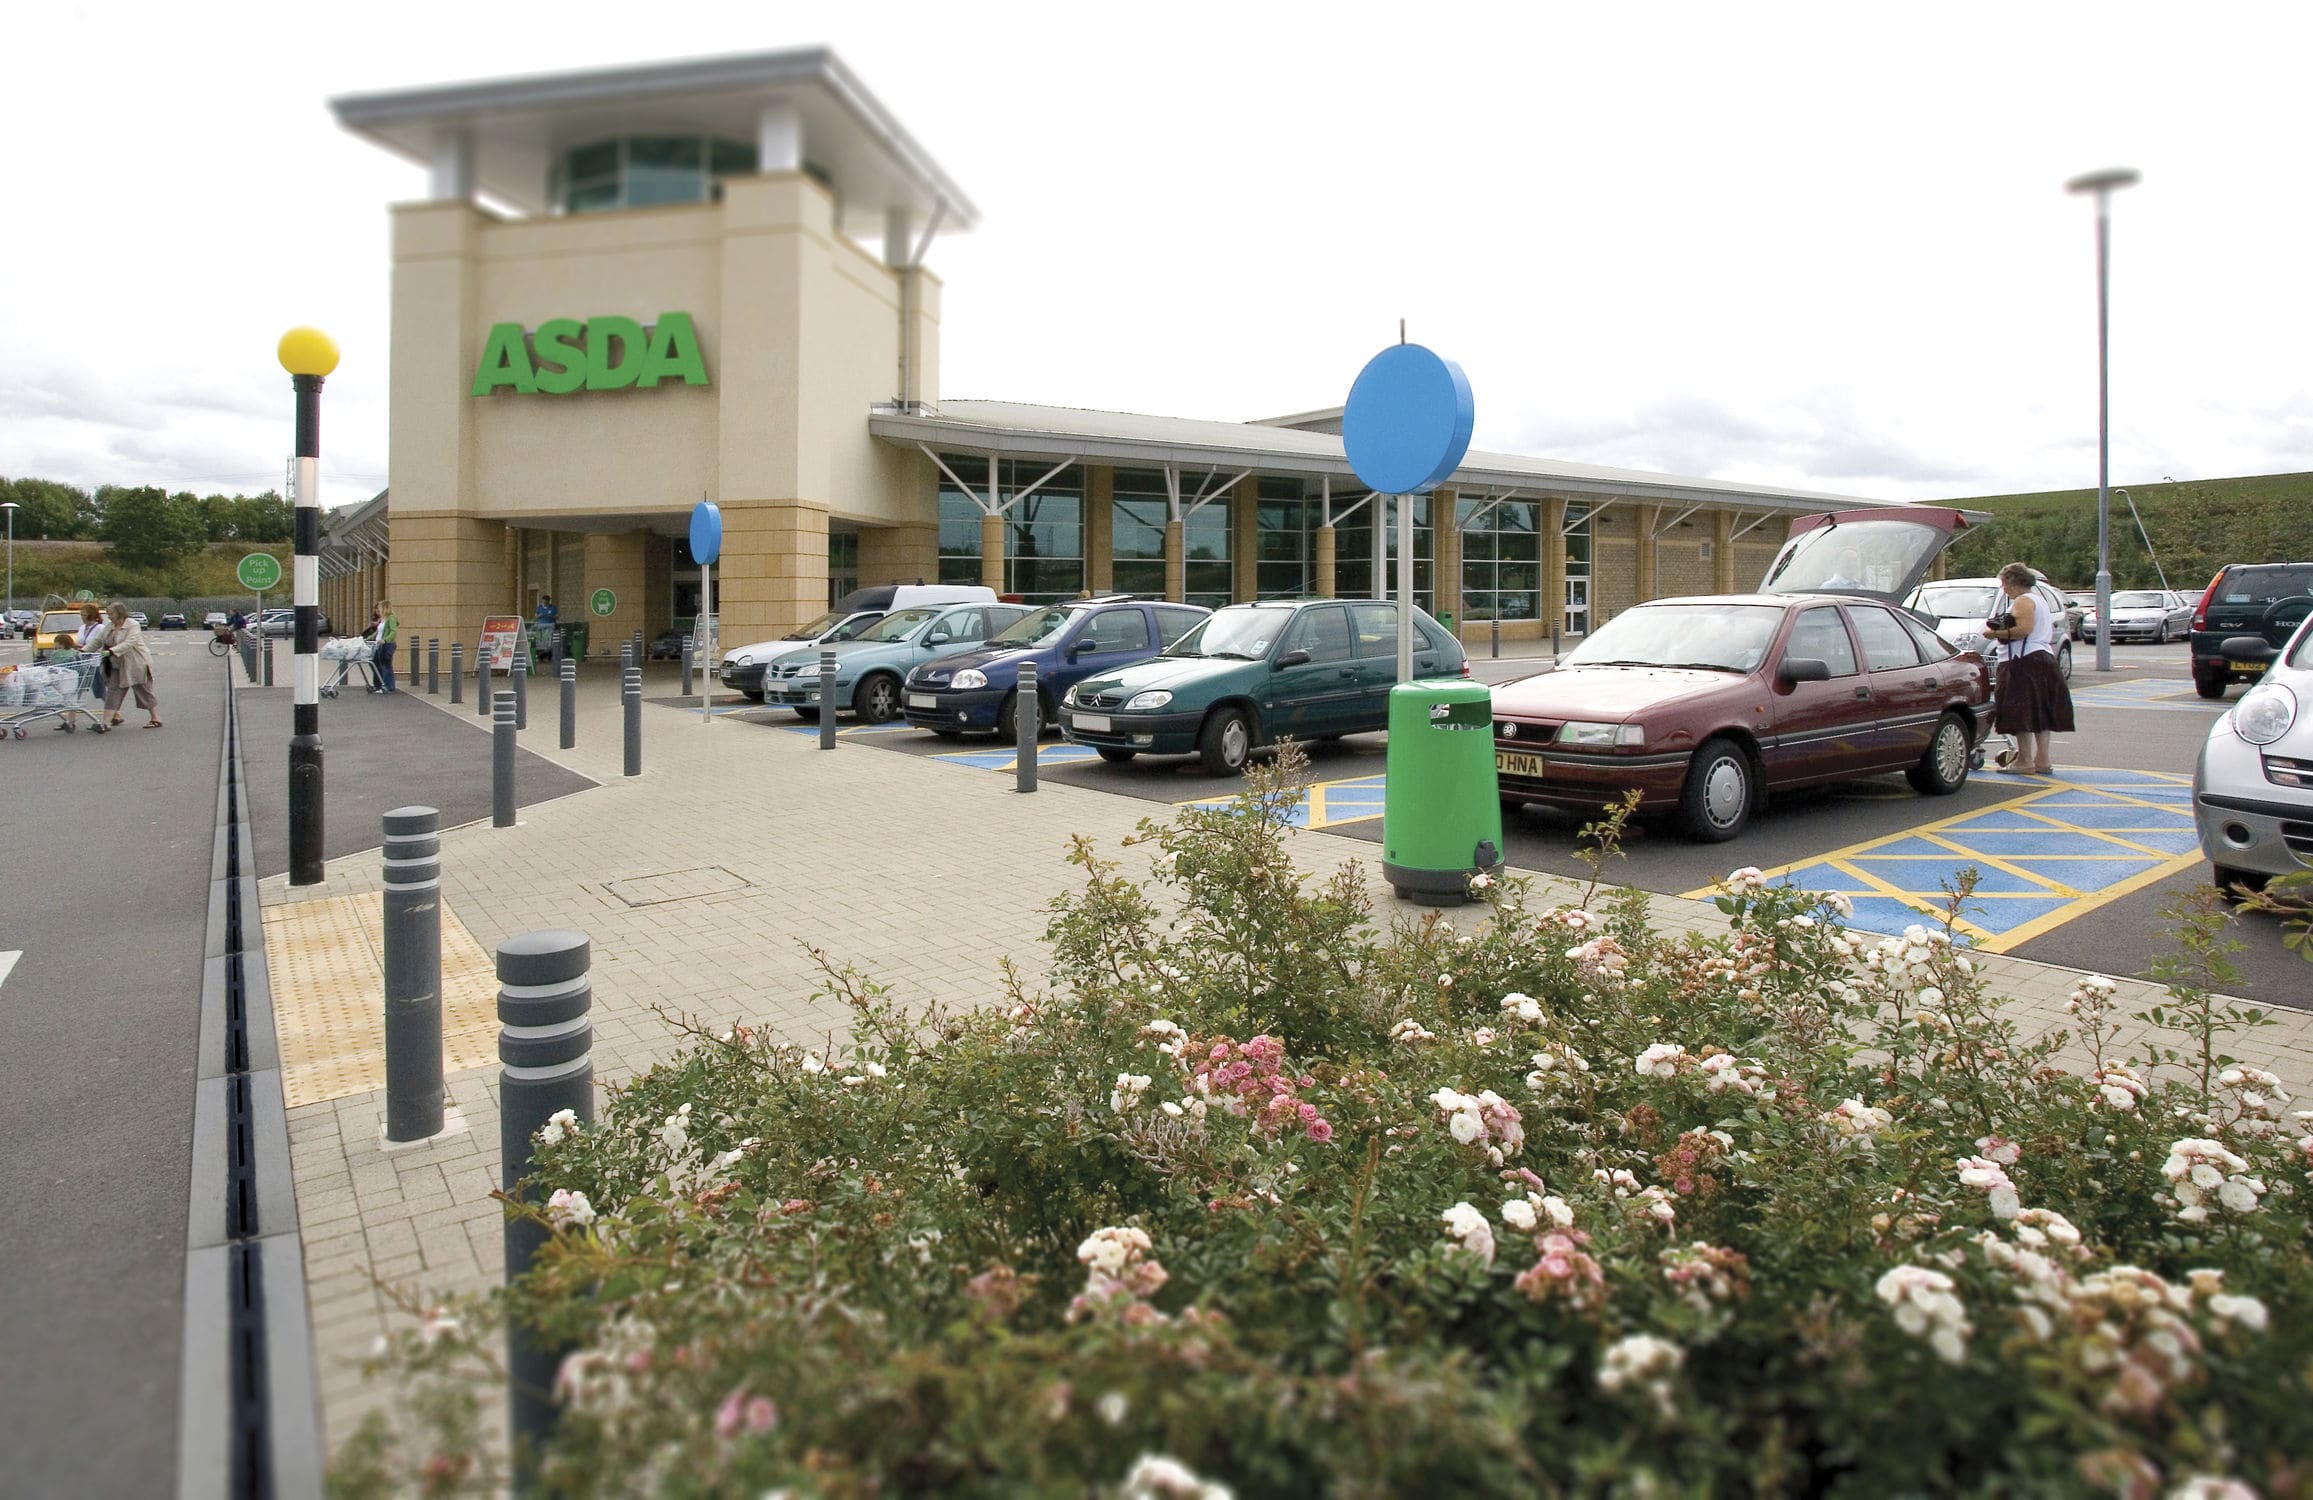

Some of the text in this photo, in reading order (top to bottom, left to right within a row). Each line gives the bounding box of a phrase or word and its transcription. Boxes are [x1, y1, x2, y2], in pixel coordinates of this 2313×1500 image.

[471, 311, 708, 396] ASDA
[249, 559, 269, 567] Pick
[253, 567, 266, 575] up
[246, 576, 272, 584] Point
[1506, 755, 1538, 774] HNA
